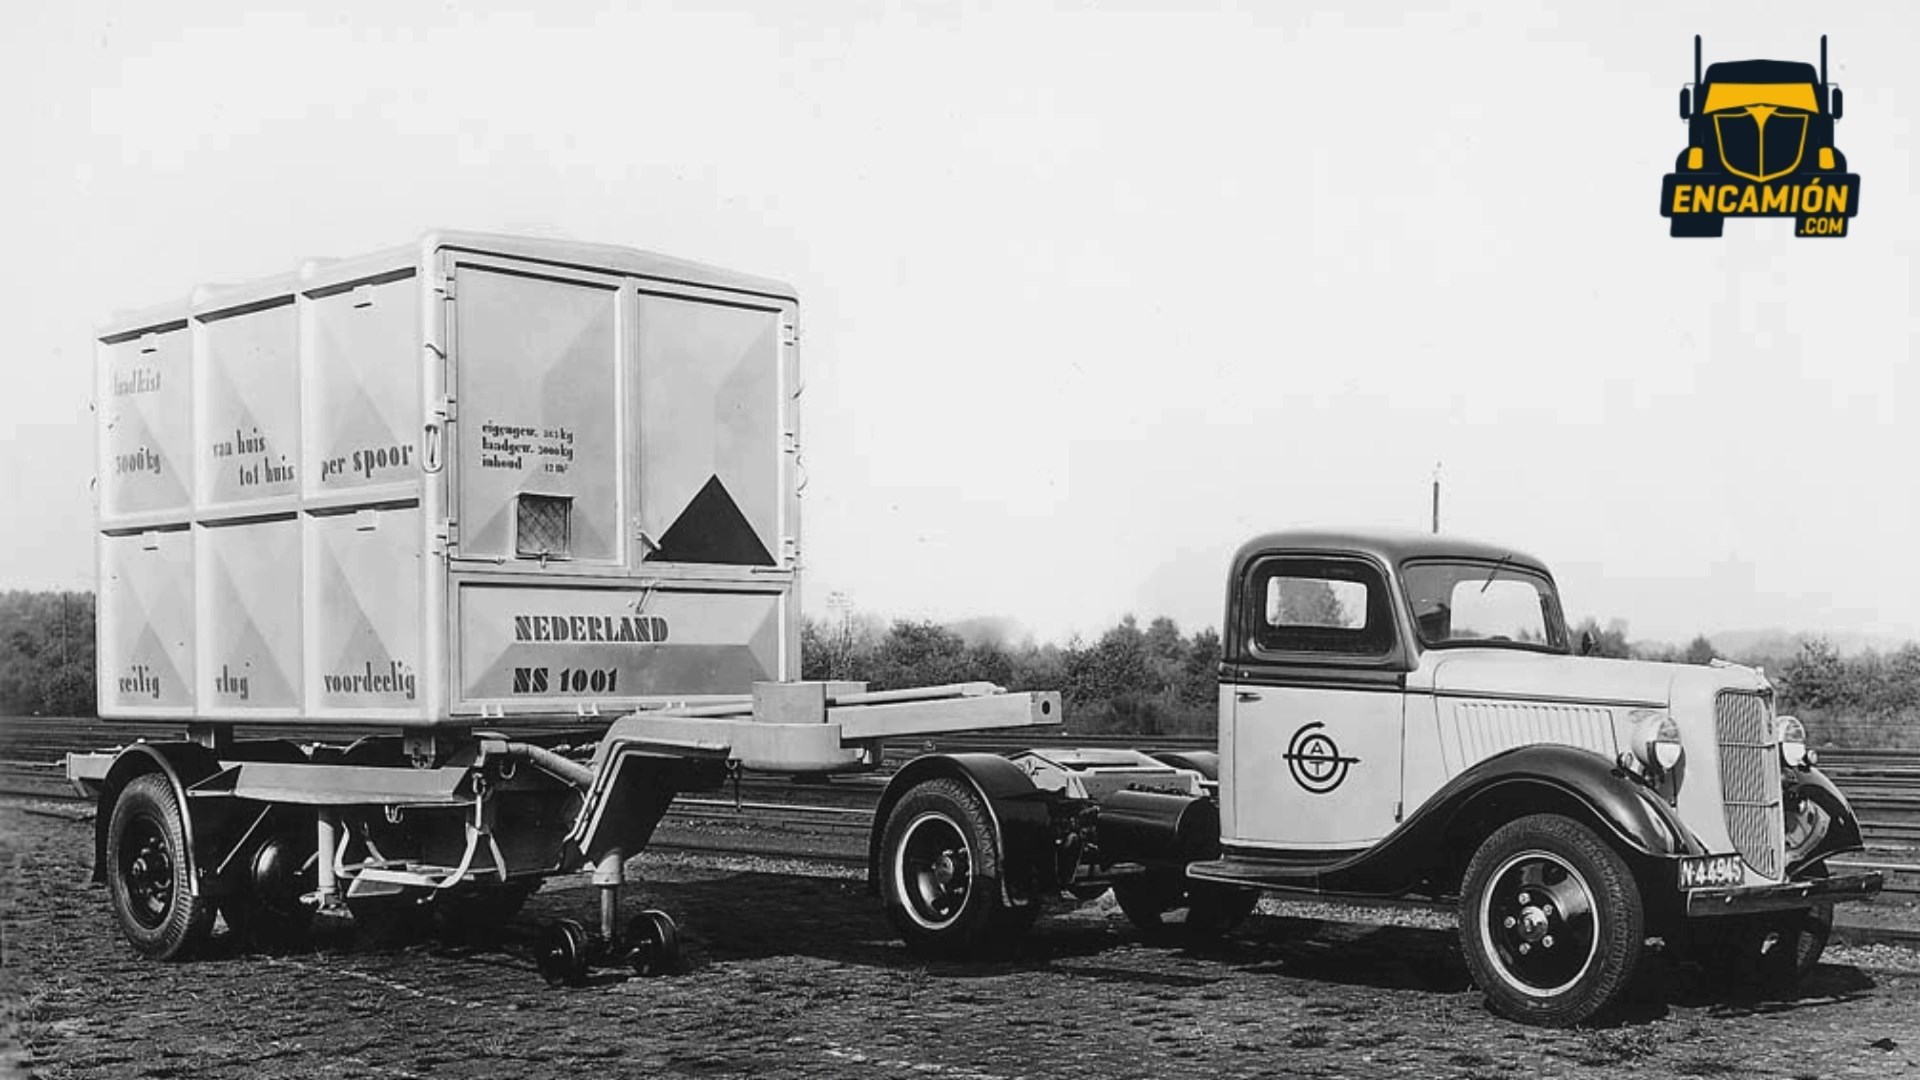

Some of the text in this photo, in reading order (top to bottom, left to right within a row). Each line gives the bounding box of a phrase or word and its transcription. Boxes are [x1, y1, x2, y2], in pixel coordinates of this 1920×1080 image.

[236, 427, 266, 455] huis
[240, 454, 294, 486] tot huis
[321, 445, 413, 482] per spoor
[515, 615, 669, 643] NEDERLAND
[215, 664, 250, 700] vlug
[324, 661, 416, 700] voordeelig
[513, 667, 618, 693] NS 1001
